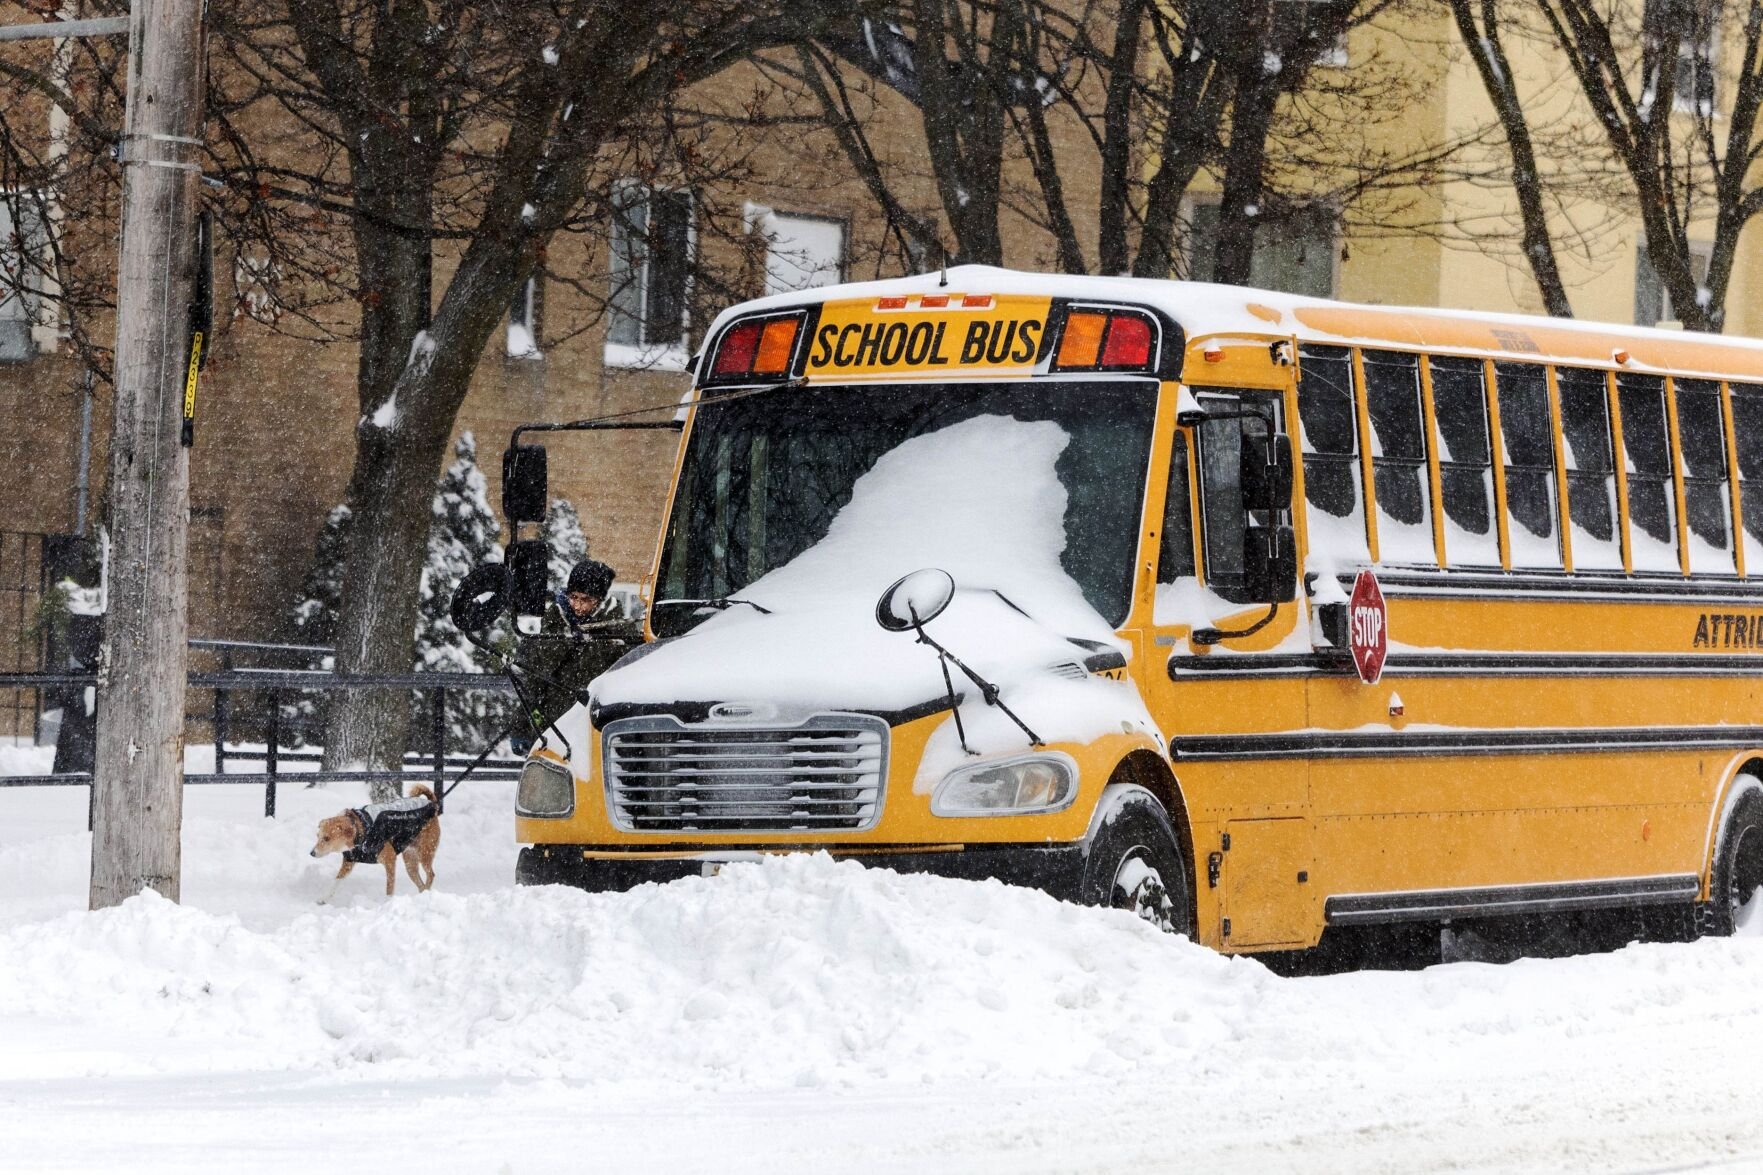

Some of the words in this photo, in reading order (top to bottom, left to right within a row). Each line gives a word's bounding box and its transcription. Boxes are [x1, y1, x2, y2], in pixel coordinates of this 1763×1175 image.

[811, 321, 949, 368] SCHOOL
[959, 319, 1041, 364] BUS
[1354, 606, 1382, 648] STOP
